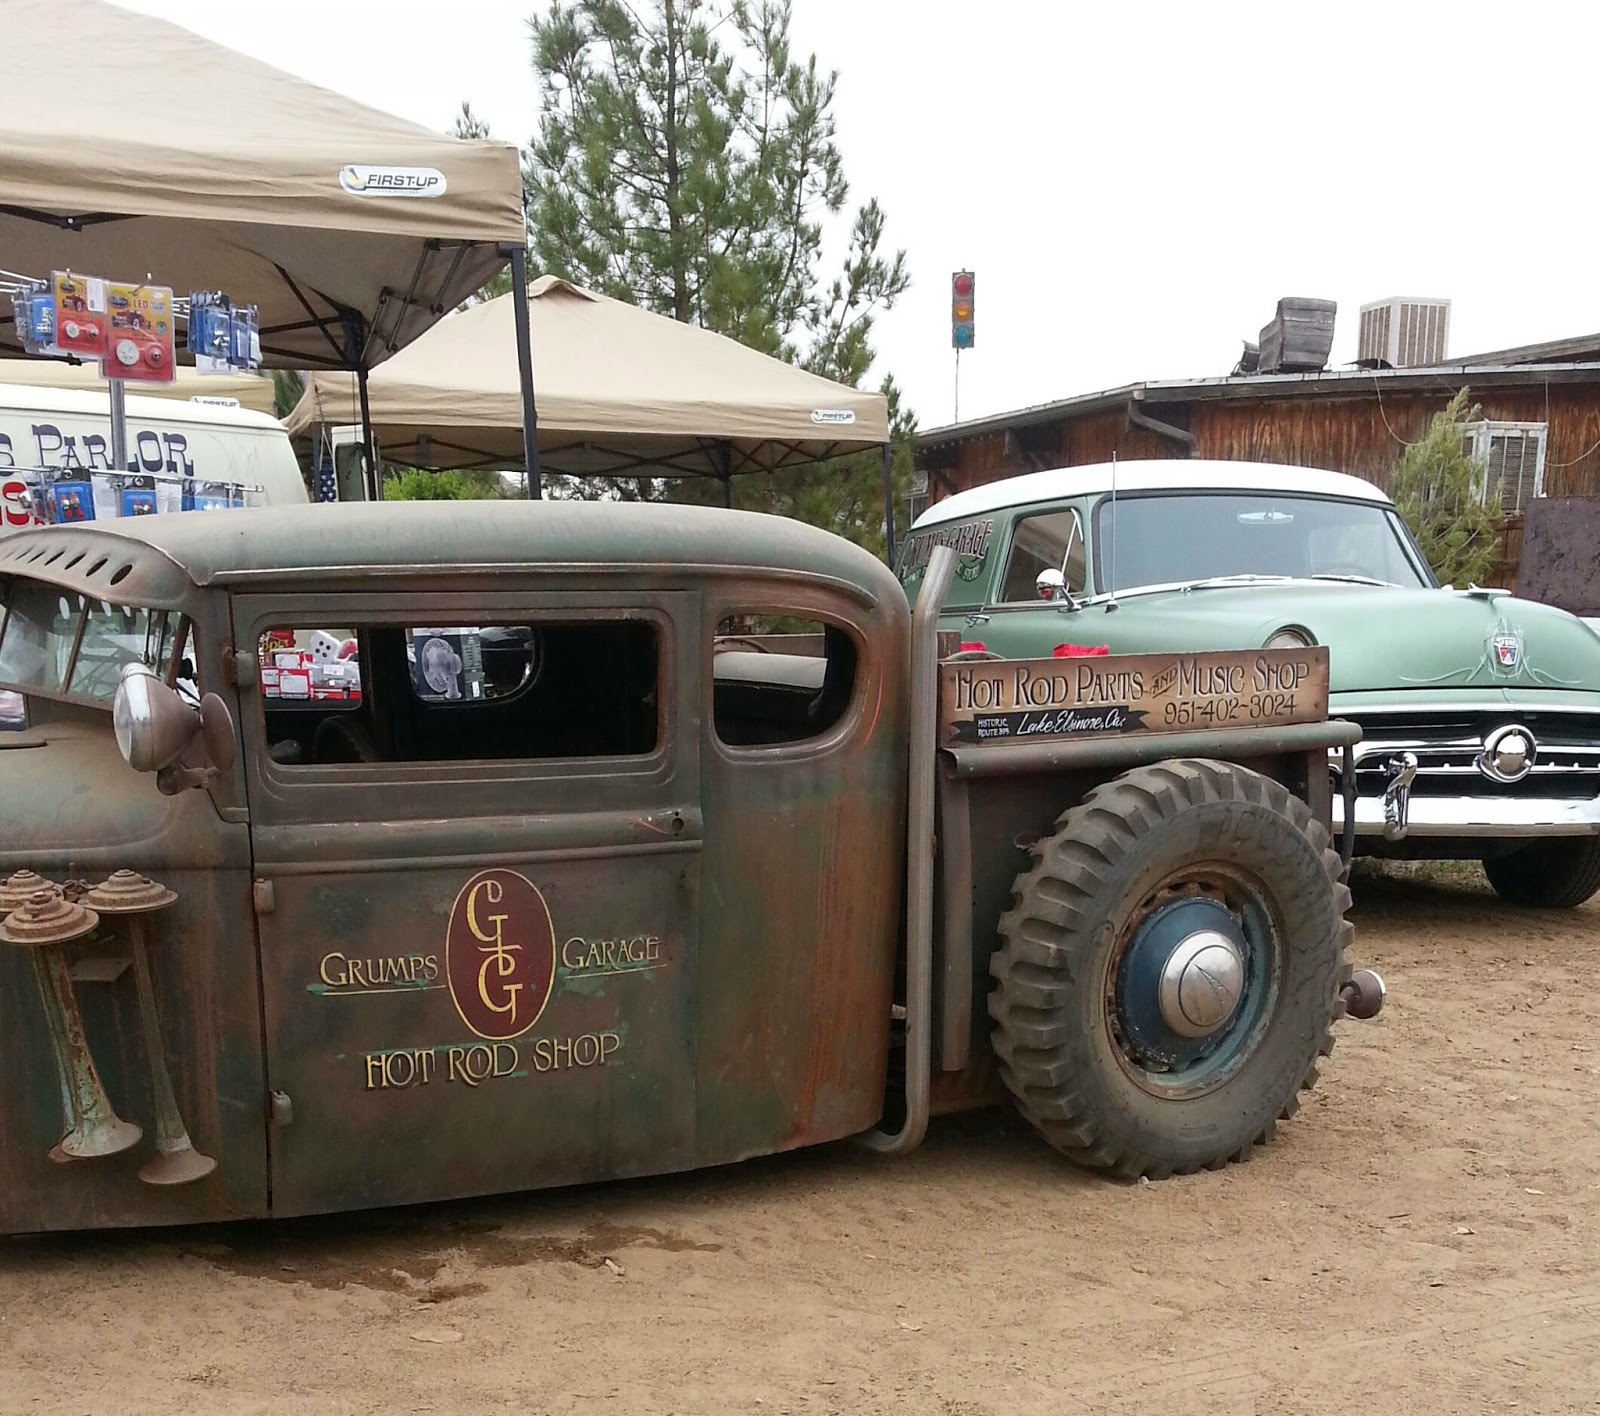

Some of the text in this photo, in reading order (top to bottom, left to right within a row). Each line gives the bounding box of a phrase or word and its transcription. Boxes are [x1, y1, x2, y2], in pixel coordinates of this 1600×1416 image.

[954, 656, 1310, 711] HOT ROD PARTS AND MUSIC SHOP
[977, 717, 1009, 728] HISTORIC
[1016, 713, 1054, 735] Lake
[1053, 709, 1104, 734] Elsinore,
[1164, 694, 1298, 725] 951-402-3024
[977, 728, 998, 738] ROUTE
[319, 937, 661, 987] GRUMPS GARAGE
[365, 1033, 621, 1090] HOT ROD SHOP
